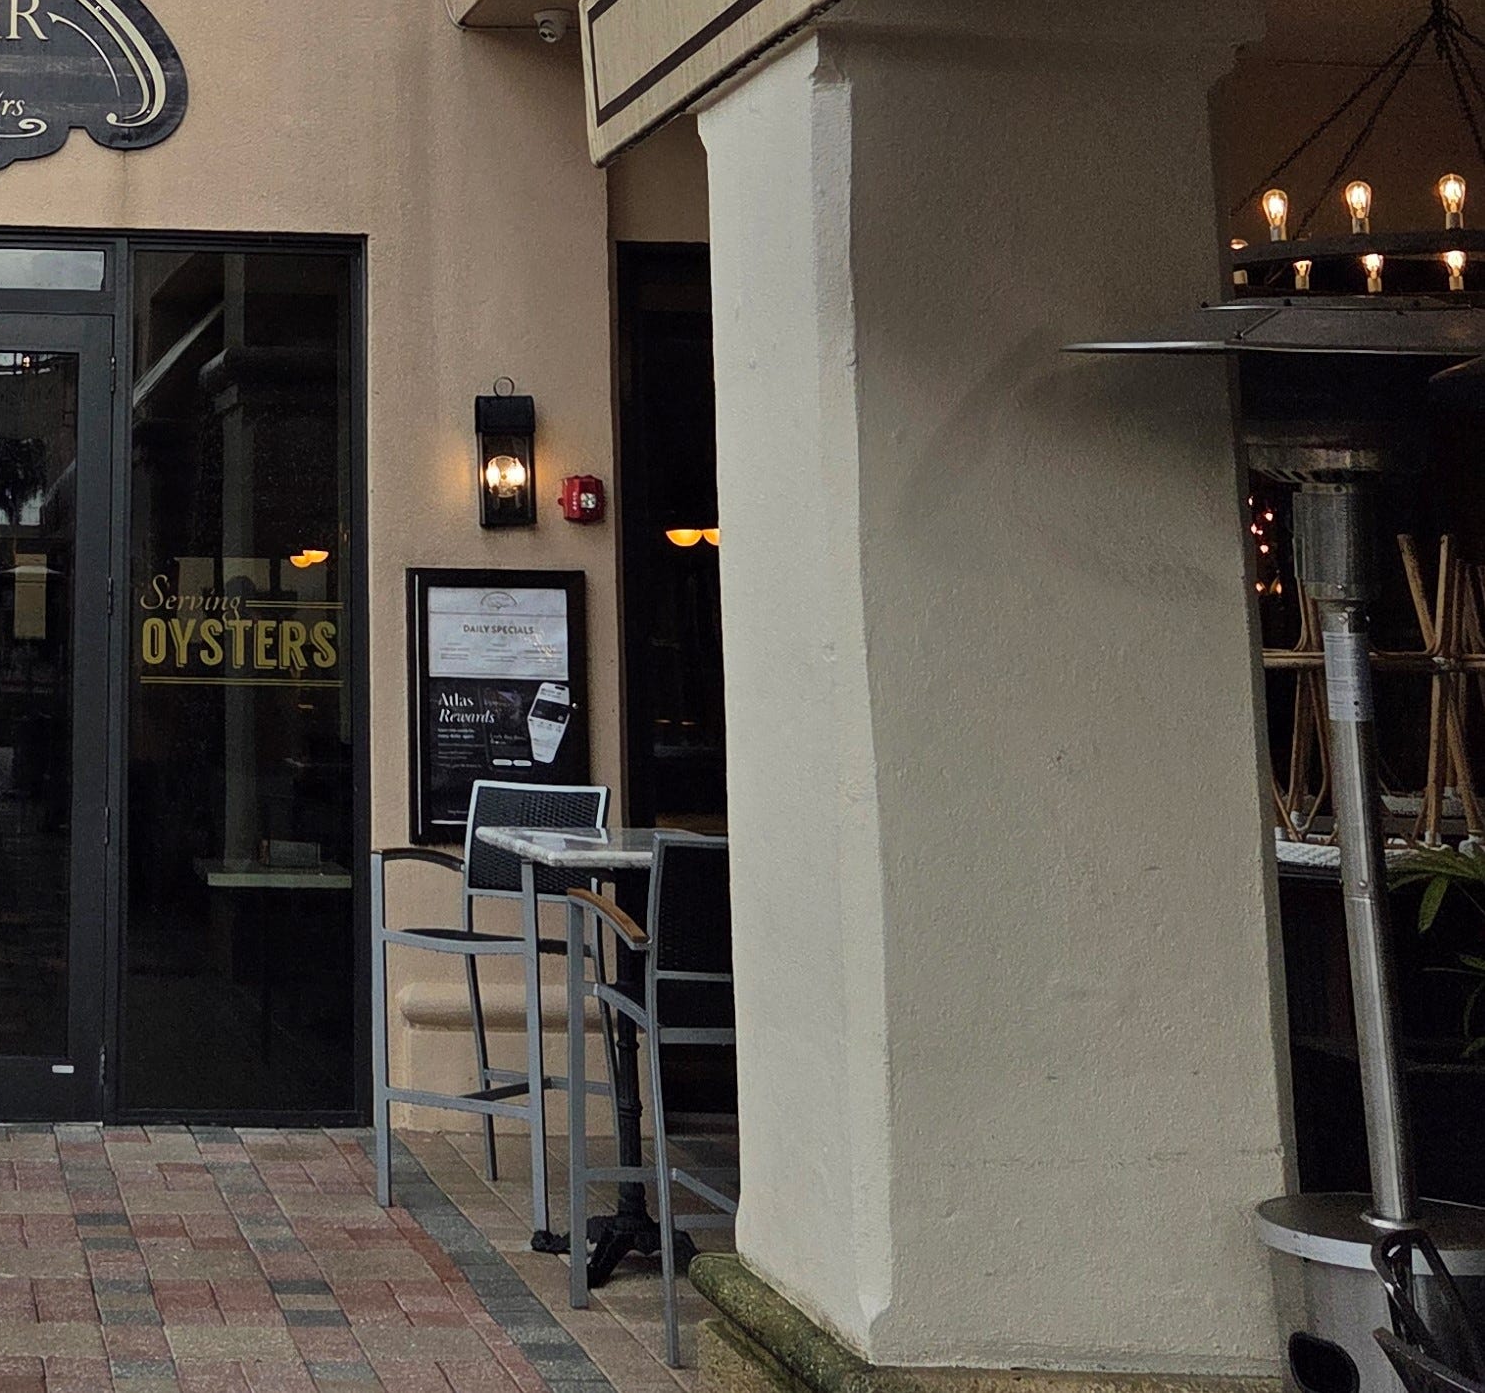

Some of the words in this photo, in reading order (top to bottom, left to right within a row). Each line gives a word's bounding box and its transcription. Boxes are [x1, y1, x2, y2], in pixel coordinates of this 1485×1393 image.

[140, 574, 242, 624] Serving
[463, 624, 490, 634] DAILY
[492, 624, 535, 635] SPECIALS
[141, 617, 338, 670] OYSTERS
[438, 692, 474, 707] Atlas
[439, 708, 495, 723] Rewards
